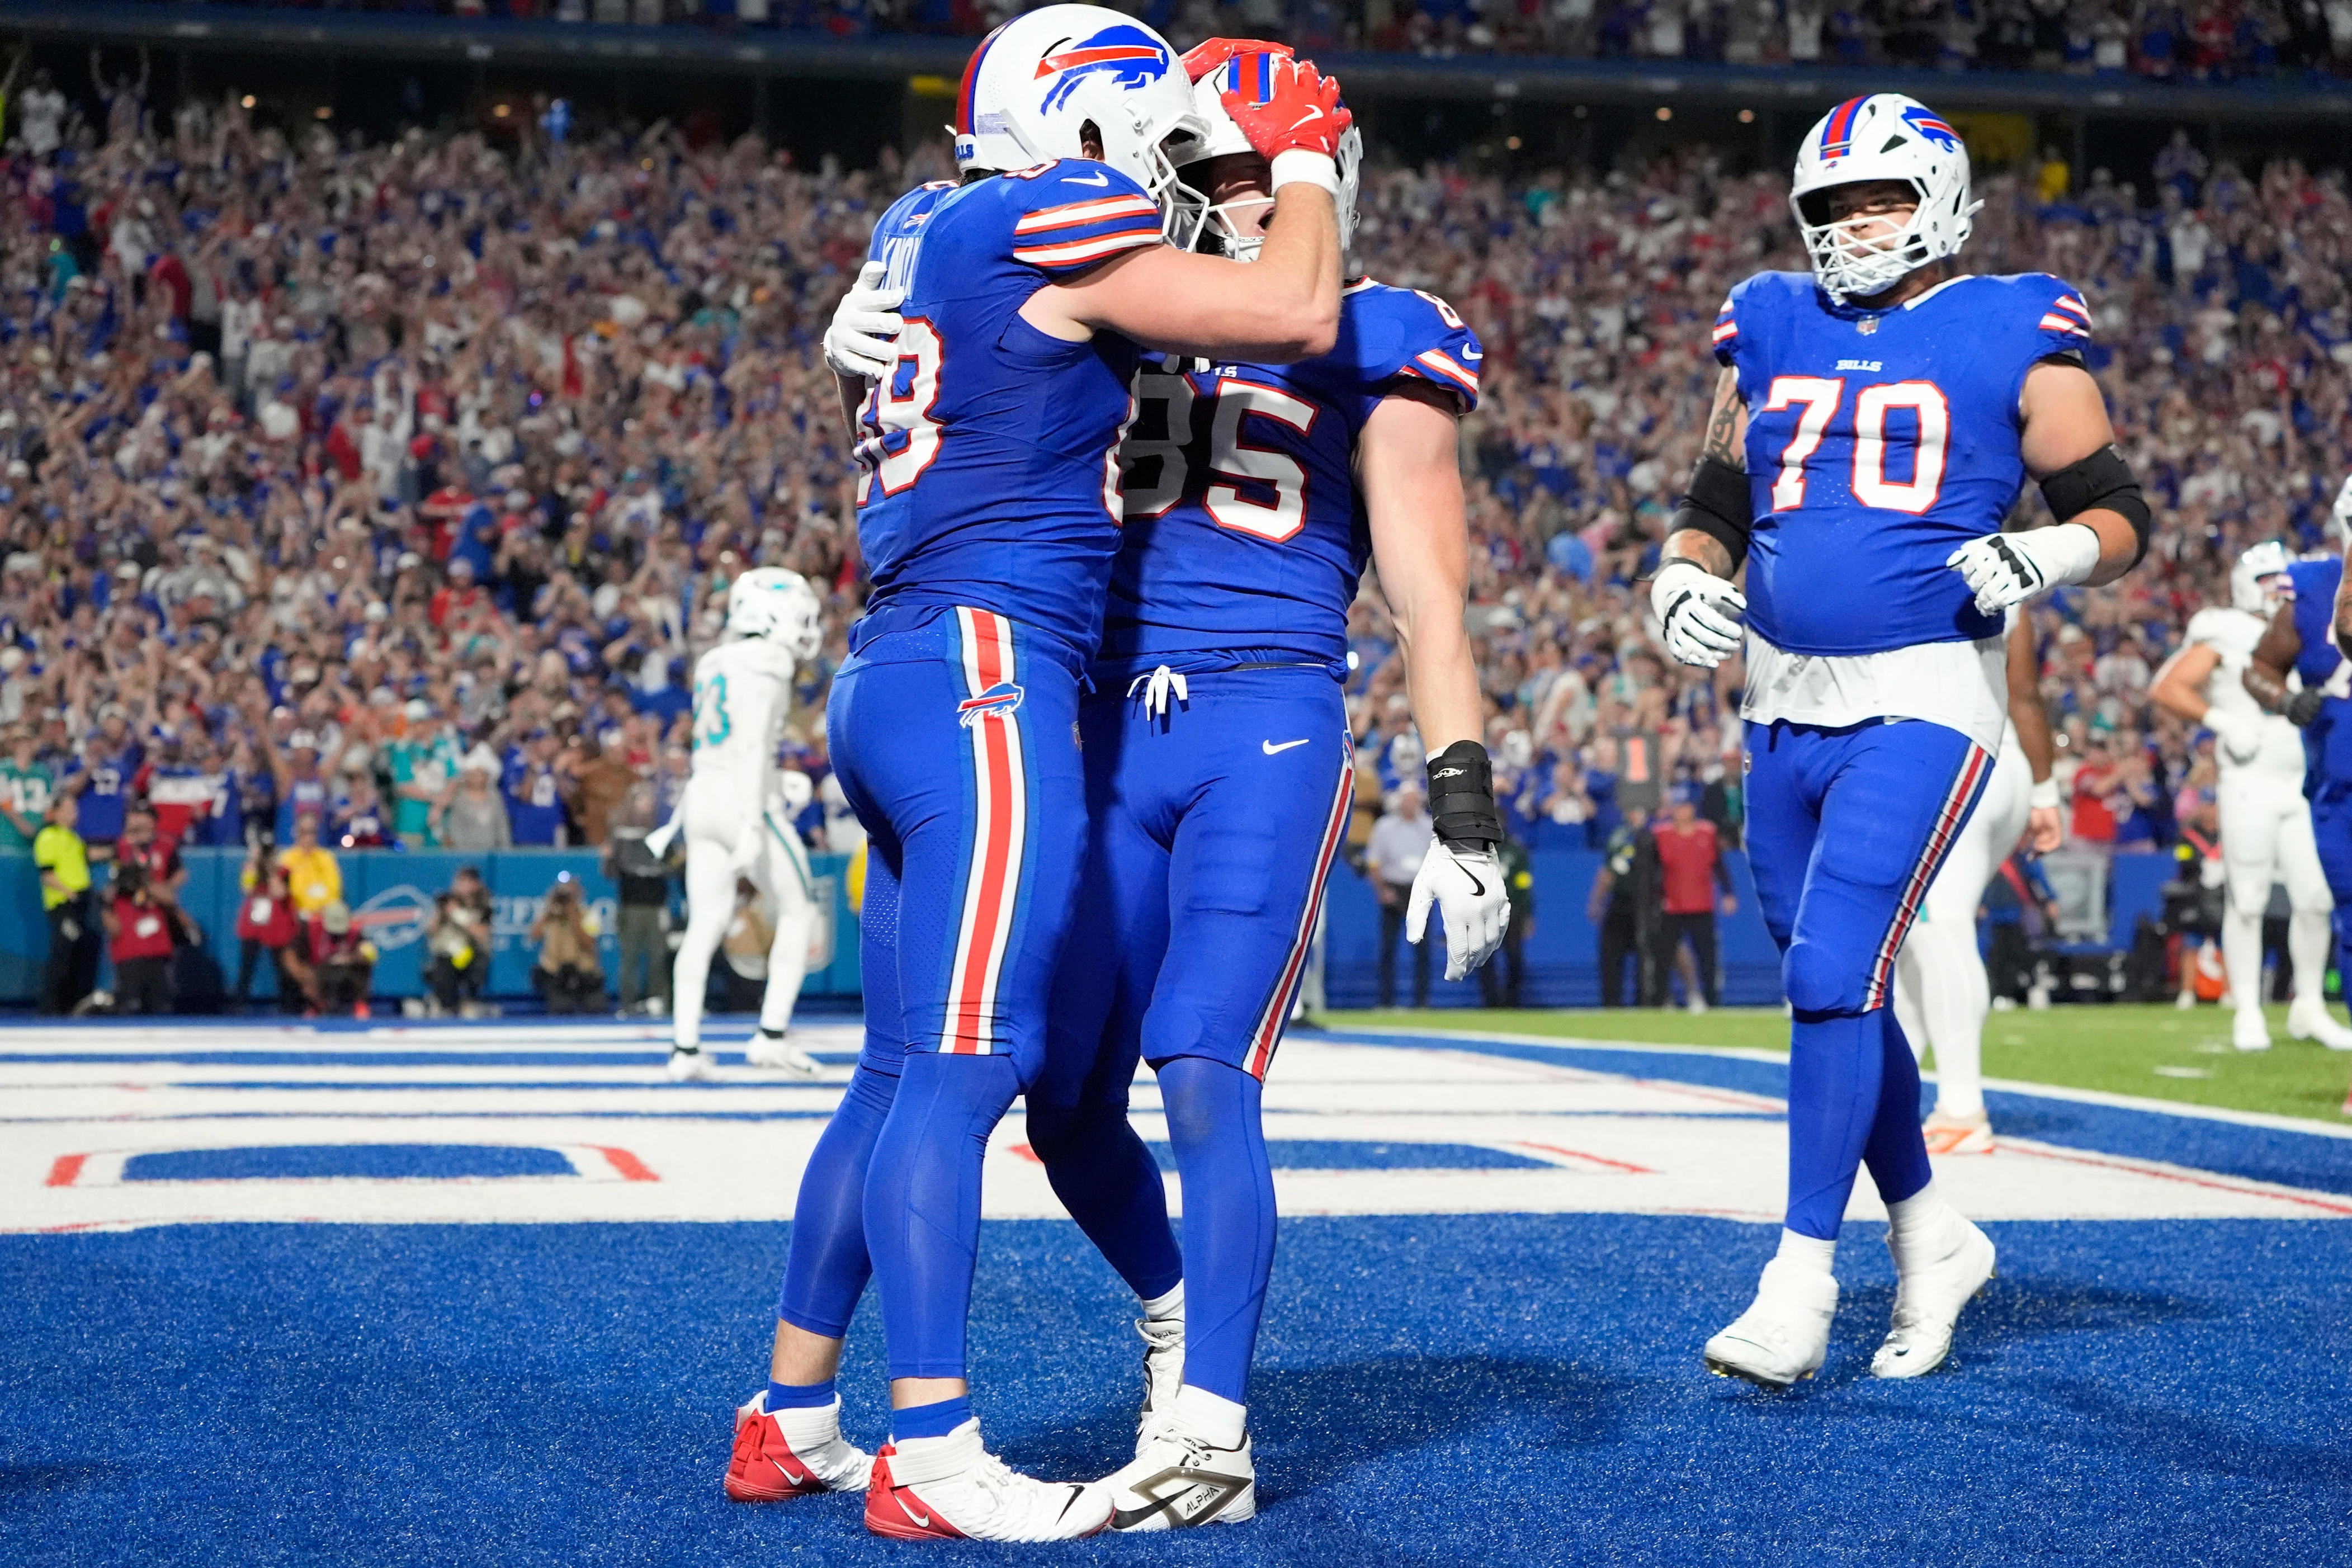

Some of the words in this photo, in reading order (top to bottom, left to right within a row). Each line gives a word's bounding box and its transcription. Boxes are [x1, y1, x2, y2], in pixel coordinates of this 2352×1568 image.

[1835, 360, 1883, 372] BILLS
[1118, 371, 1322, 544] 85
[1761, 375, 1950, 516] 70
[1627, 736, 1649, 782] 1
[1186, 1486, 1220, 1517] ALPHA
